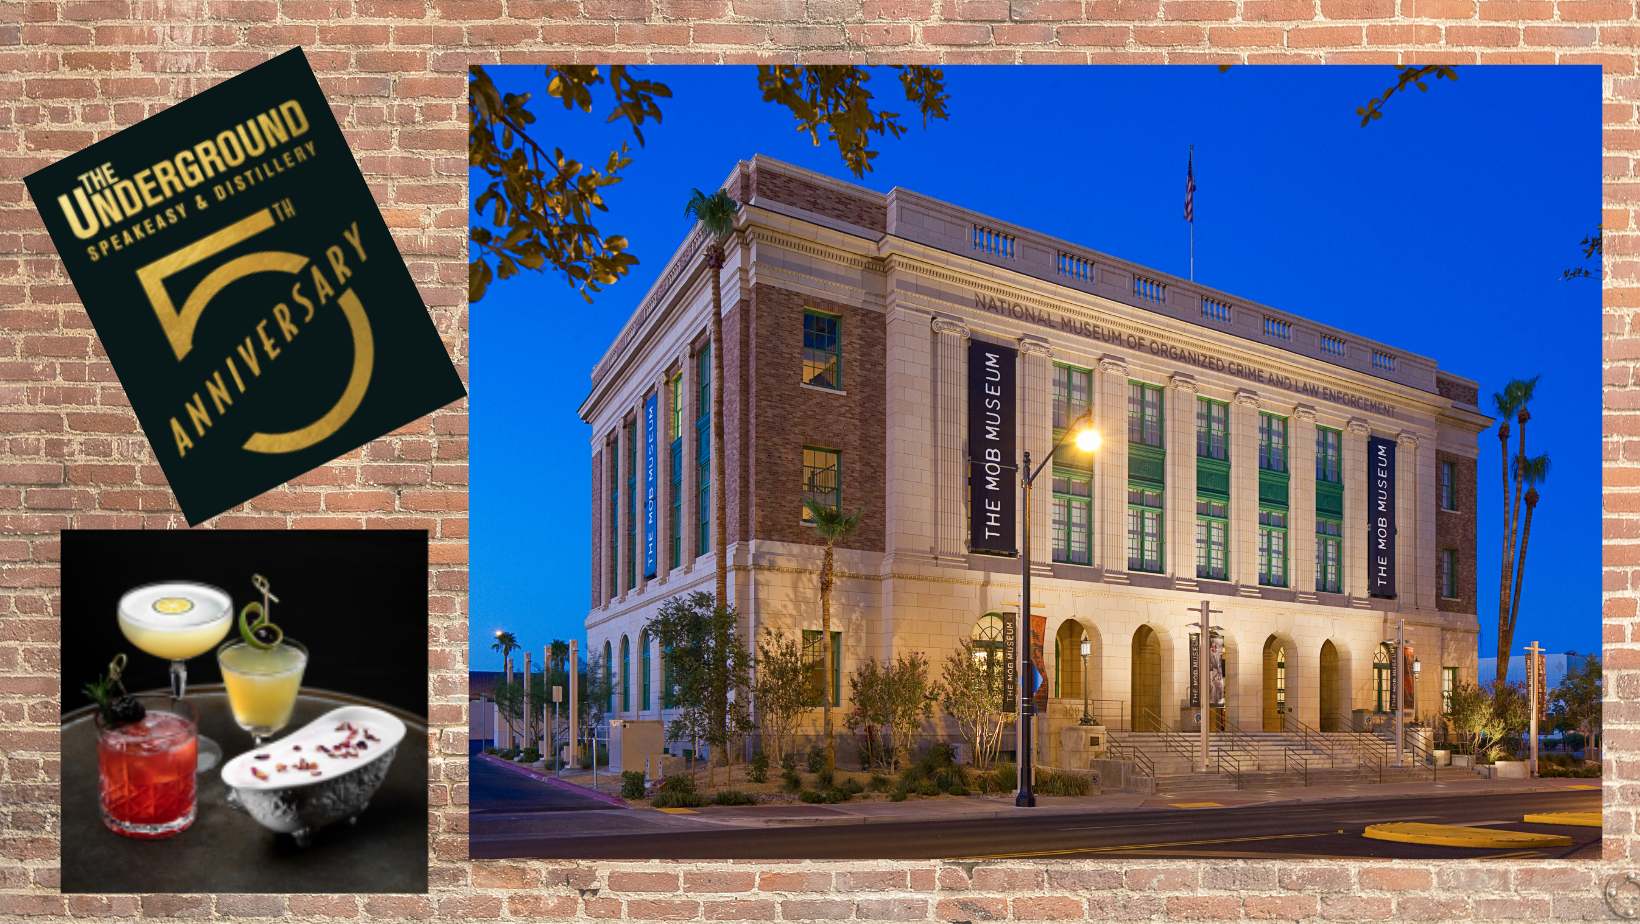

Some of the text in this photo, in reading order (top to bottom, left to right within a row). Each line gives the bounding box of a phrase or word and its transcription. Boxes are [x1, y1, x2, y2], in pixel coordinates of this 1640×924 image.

[57, 99, 310, 240] UNDERGROUND
[78, 162, 119, 195] THE
[86, 141, 317, 262] SPEAKEASY & DISTILLERY
[169, 221, 369, 459] ANNIVERSARY
[974, 291, 1396, 418] NATIONAL MUSEUM OF ORGANIZED CRIME AND LAW ENFORCEMENT
[985, 352, 1001, 540] THE MOB MUSEUM
[1377, 444, 1388, 587] THE MOB MUSEUM
[1006, 622, 1014, 660] MUSEUM
[1006, 685, 1014, 702] THE
